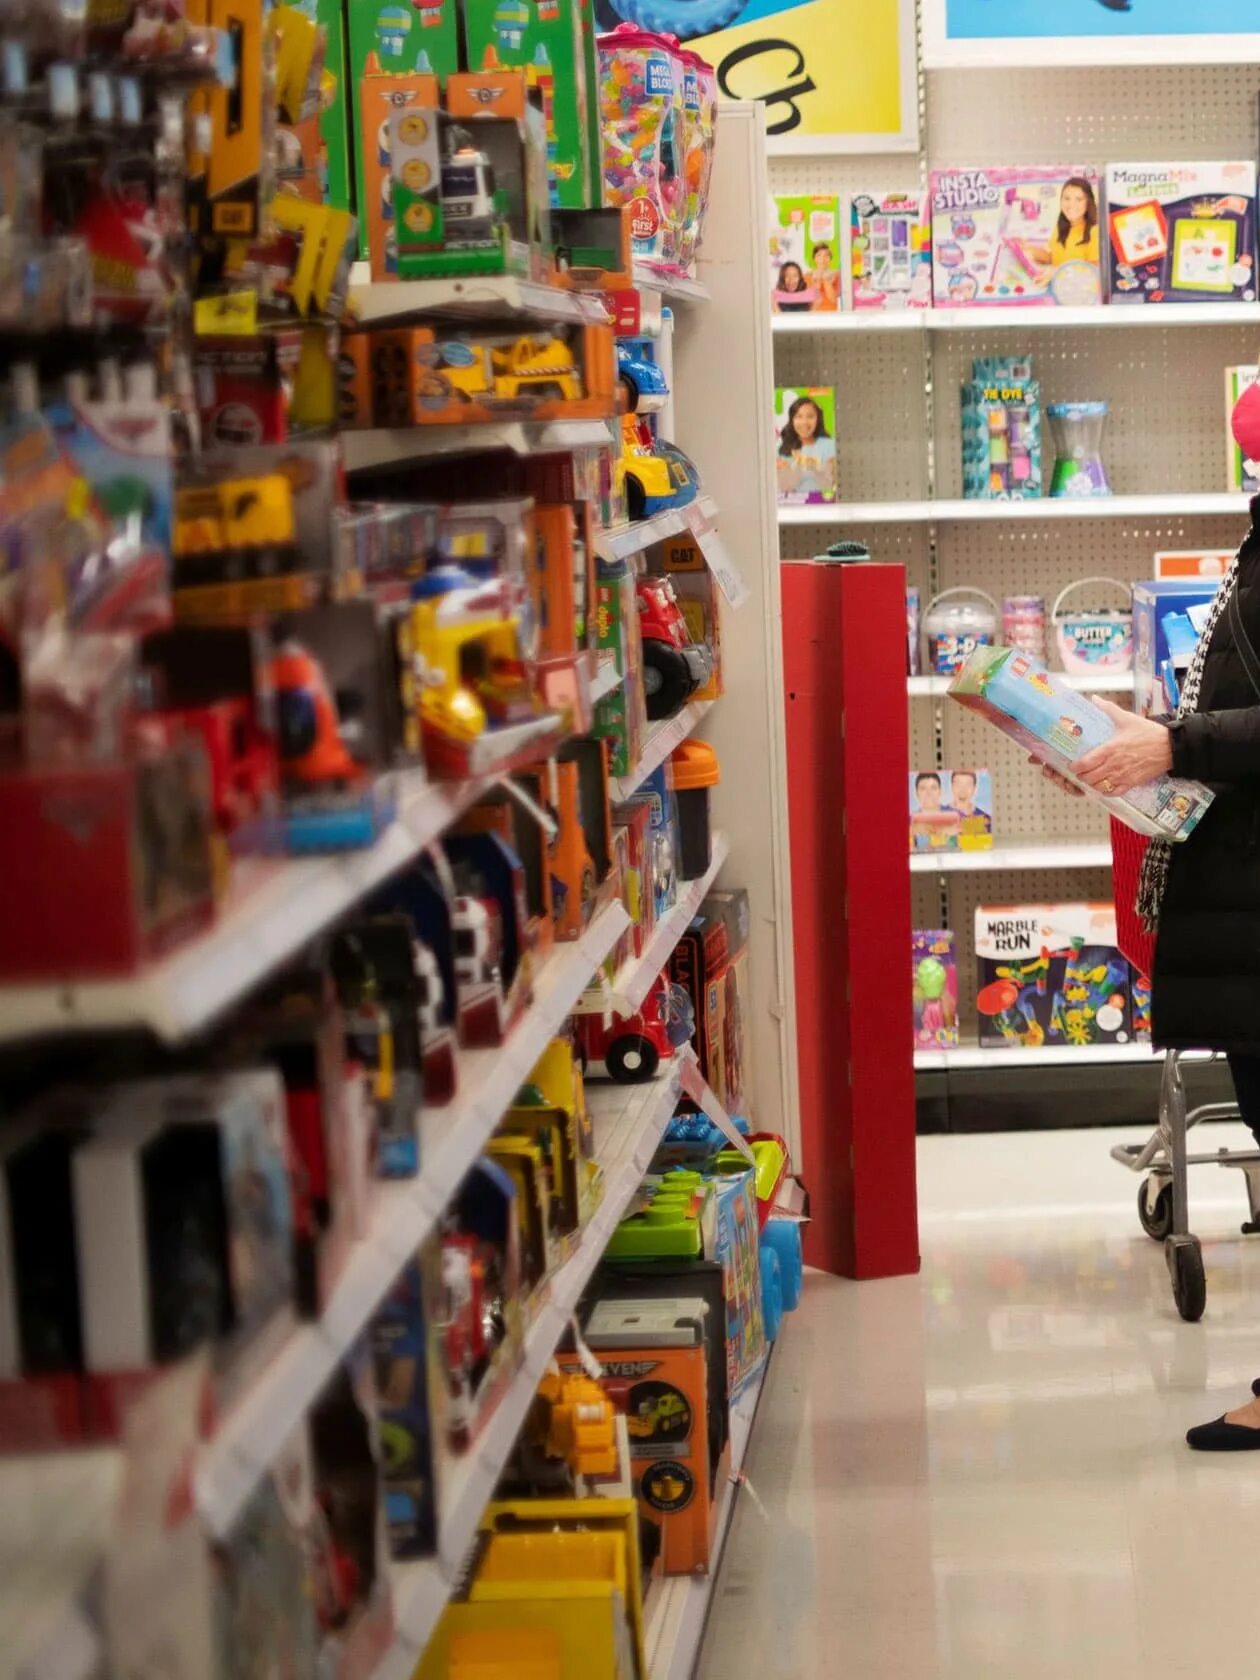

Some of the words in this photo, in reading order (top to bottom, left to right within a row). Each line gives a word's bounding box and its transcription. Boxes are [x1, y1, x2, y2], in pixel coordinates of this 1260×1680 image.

[940, 172, 989, 191] INSTA
[935, 187, 999, 209] STUDIO
[671, 549, 694, 562] CAT
[987, 919, 1038, 936] MARBLE
[995, 933, 1031, 950] RUN
